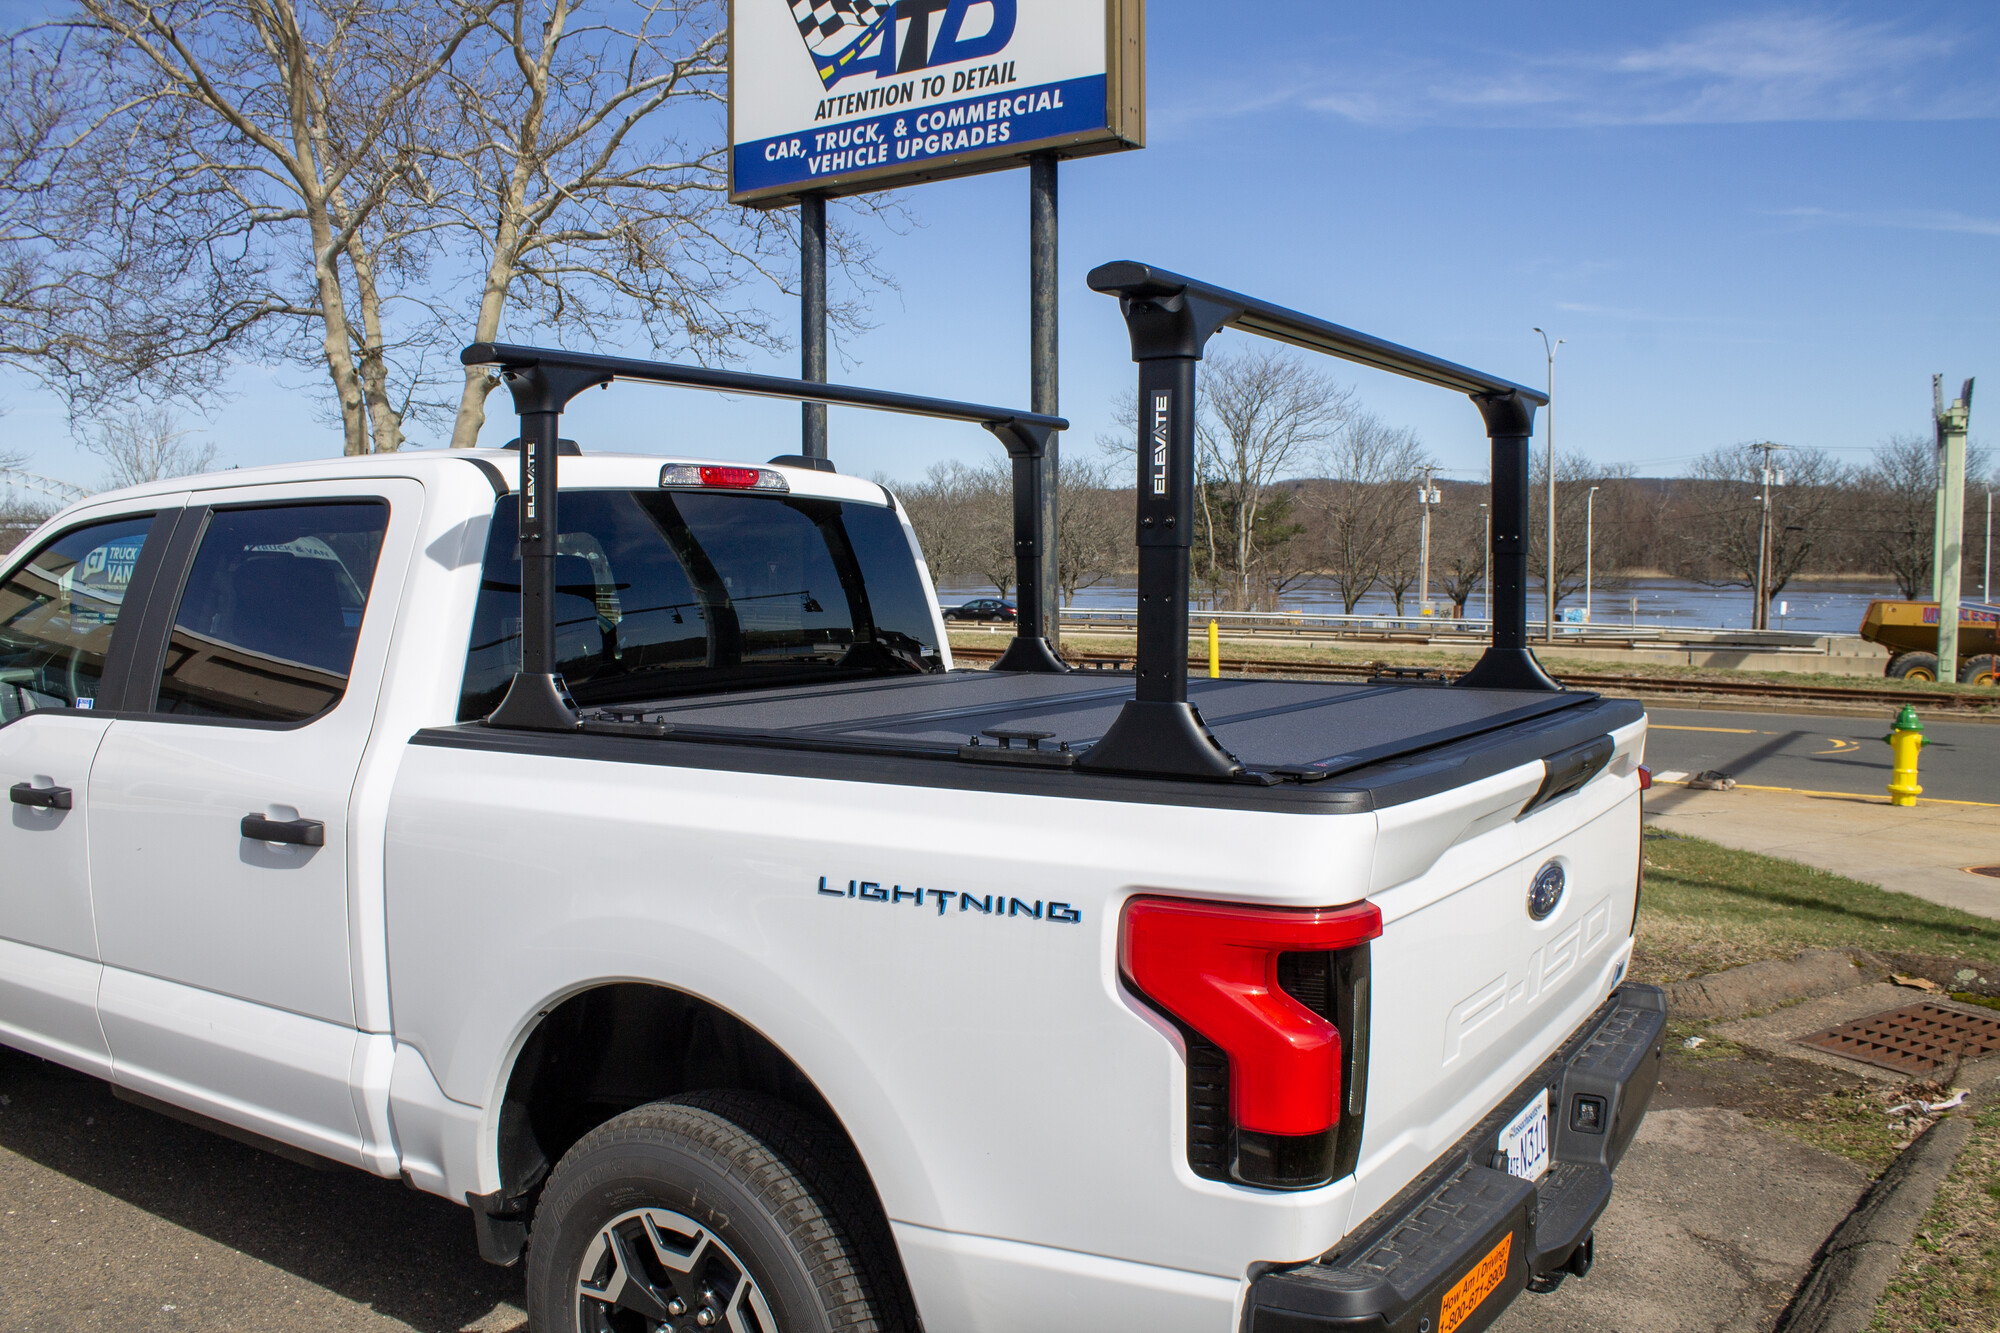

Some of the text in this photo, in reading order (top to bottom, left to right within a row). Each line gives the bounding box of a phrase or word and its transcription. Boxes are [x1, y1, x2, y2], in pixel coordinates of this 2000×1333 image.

[814, 61, 1017, 121] ATTENTION TO DETAIL
[765, 89, 1064, 161] CAR, TRUCK, & COMMERCIAL
[808, 121, 1010, 175] VEHICLE UPGRADES
[1153, 395, 1168, 495] ELEVATE
[526, 442, 536, 518] ELEVATE
[88, 551, 103, 569] CT
[107, 564, 133, 583] VAN
[109, 547, 138, 560] TRUCK
[818, 876, 1081, 923] LIGHTNING
[1442, 893, 1612, 1068] F-150
[1520, 1113, 1547, 1176] N310
[1442, 1239, 1510, 1315] How Am I Driving?
